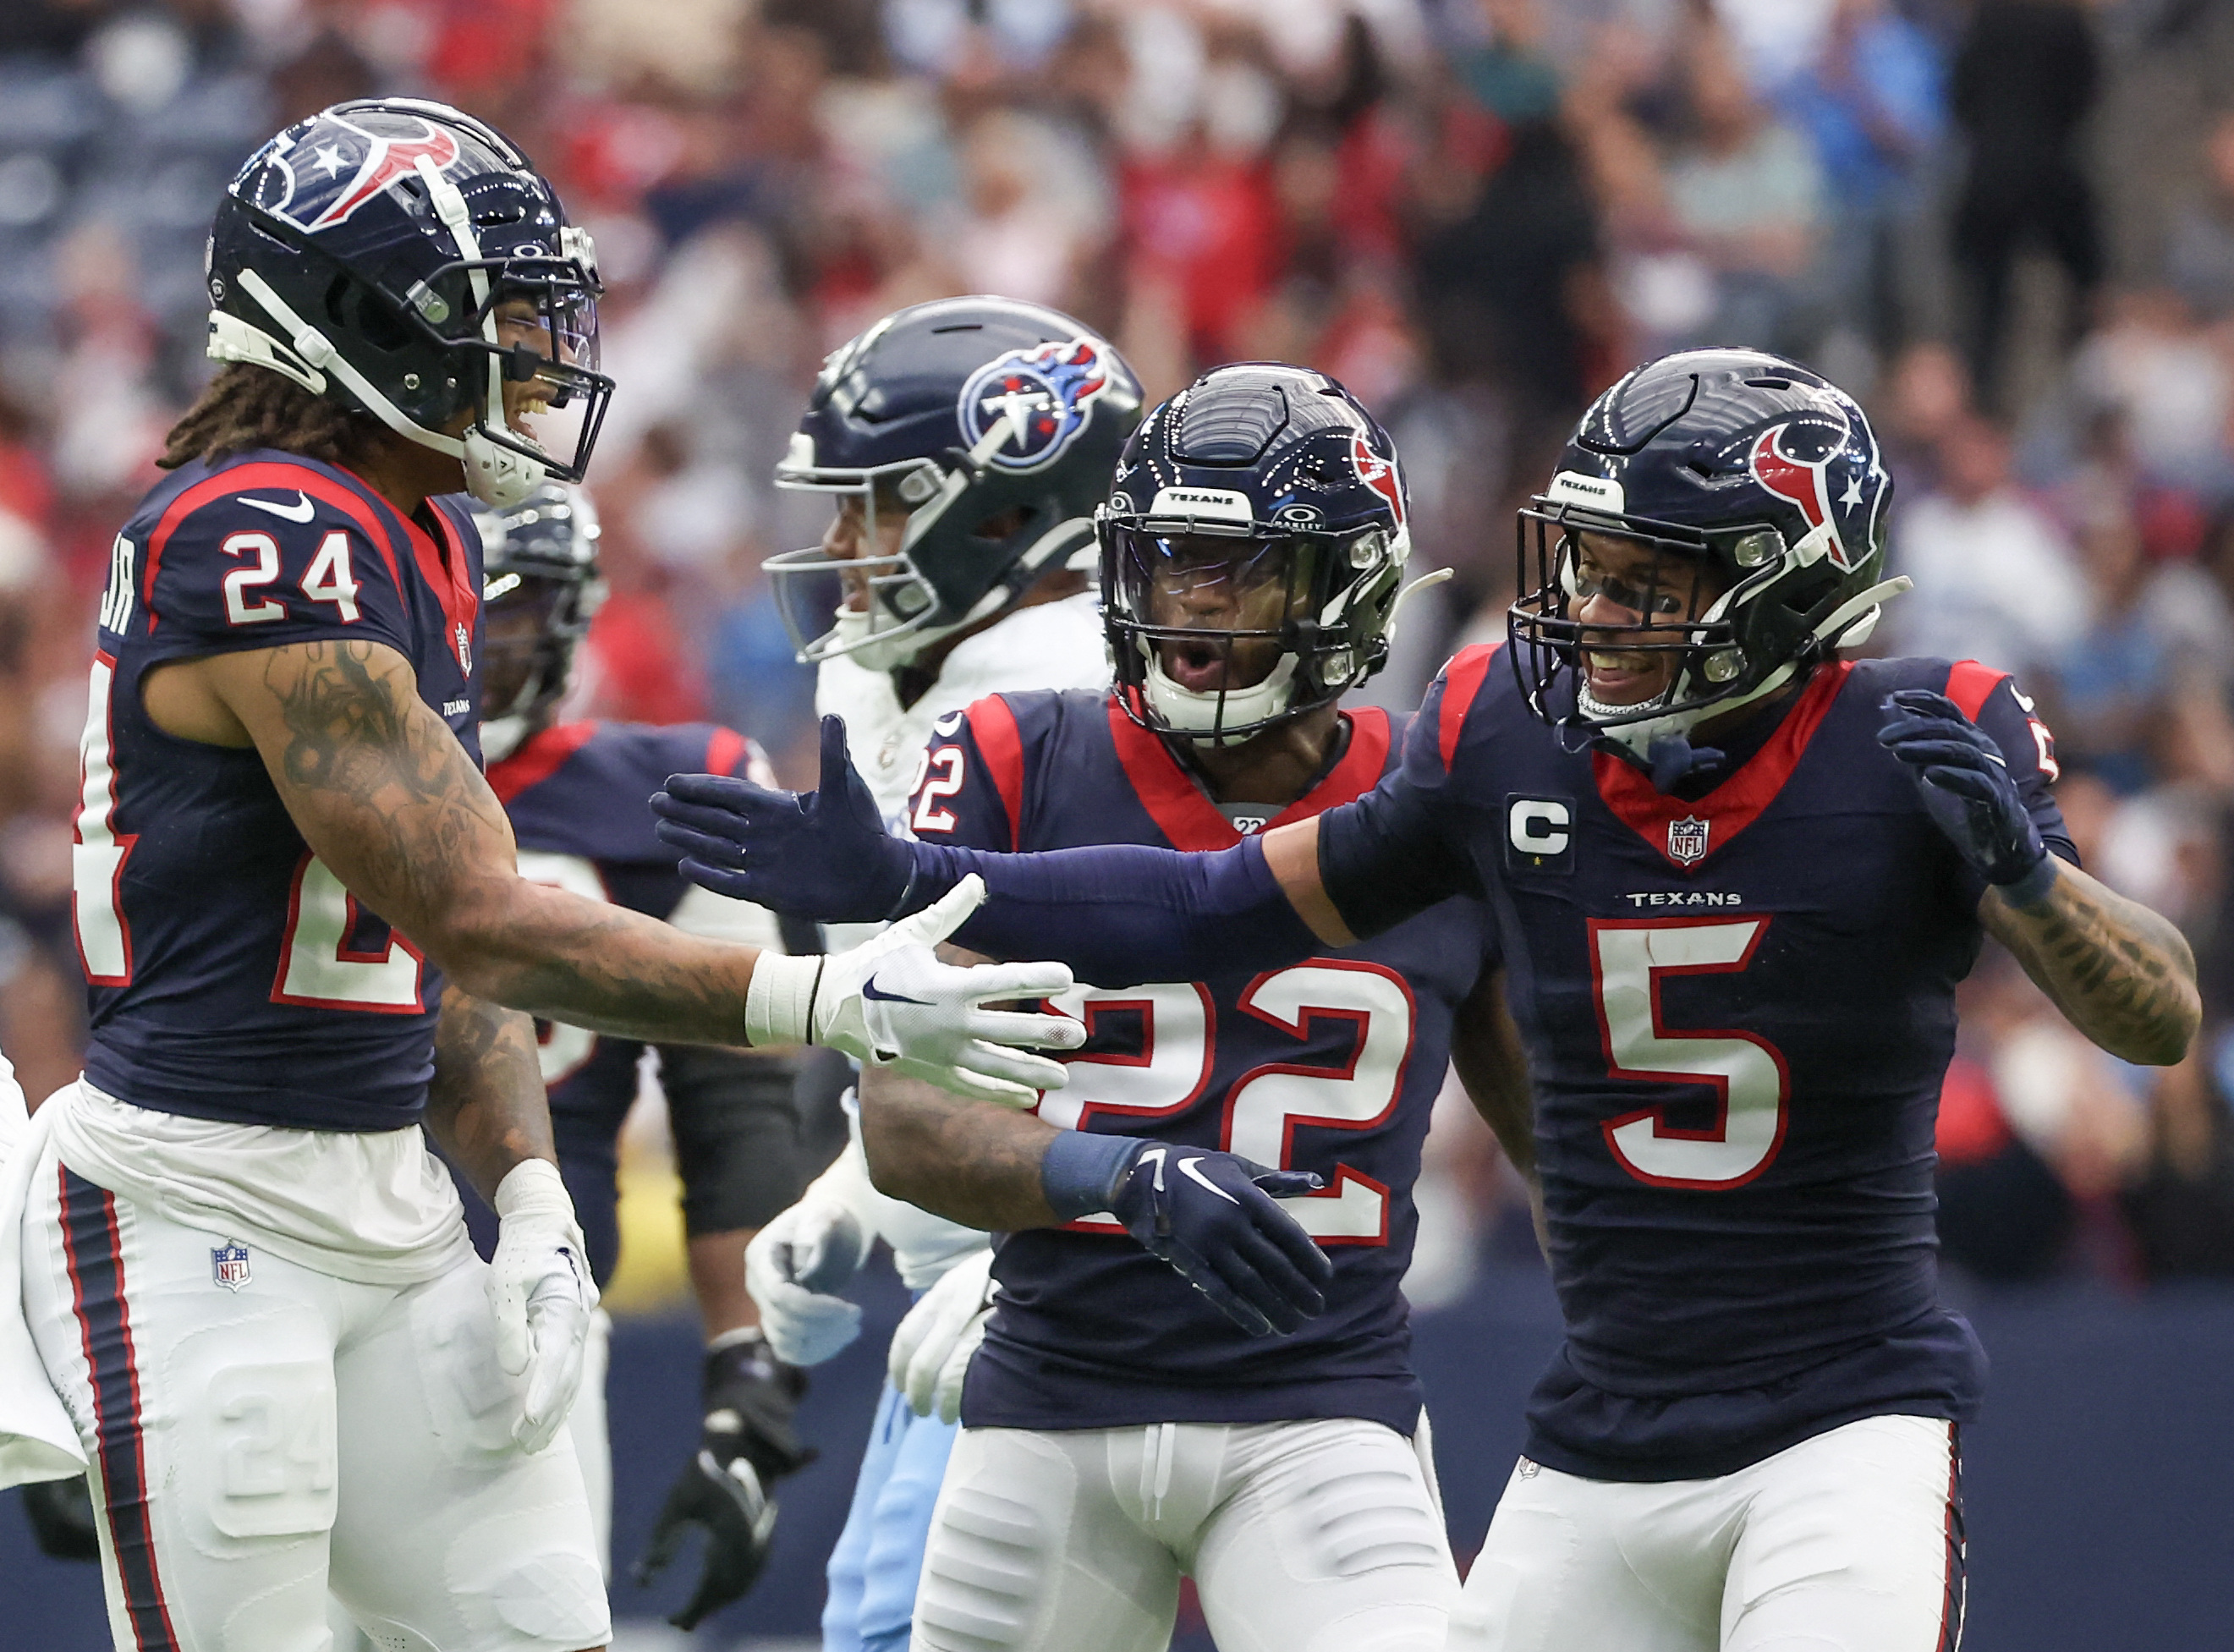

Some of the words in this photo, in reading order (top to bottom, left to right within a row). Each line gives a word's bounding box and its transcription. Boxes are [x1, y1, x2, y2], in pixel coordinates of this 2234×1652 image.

[1561, 479, 1606, 495] TEXANS
[1169, 493, 1234, 505] TEXANS
[220, 530, 363, 627] 24
[442, 700, 470, 716] TEXANS
[1510, 800, 1569, 854] C
[1674, 837, 1701, 856] NFL
[1625, 892, 1743, 908] TEXANS
[1586, 914, 1791, 1190] 5
[219, 1263, 247, 1282] NFL
